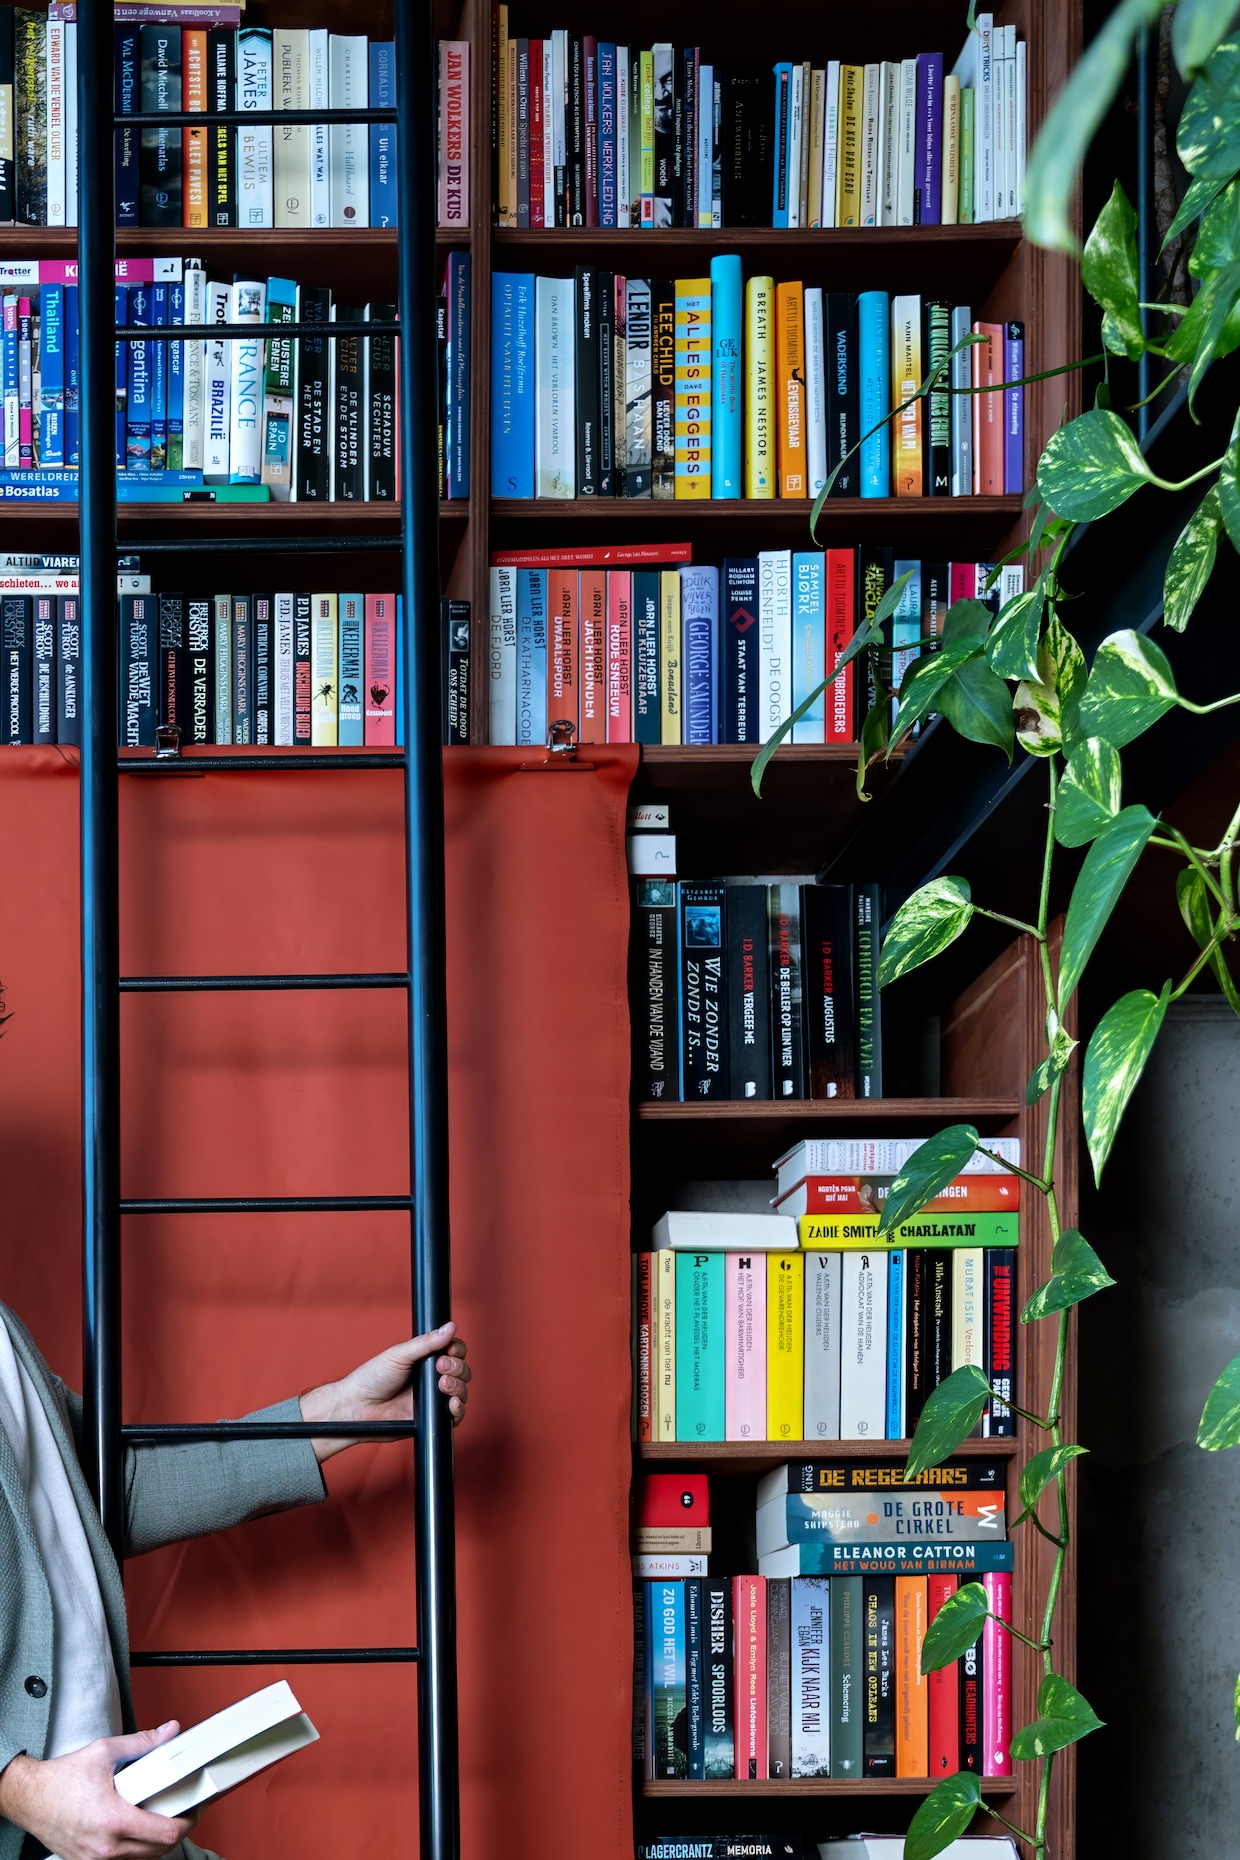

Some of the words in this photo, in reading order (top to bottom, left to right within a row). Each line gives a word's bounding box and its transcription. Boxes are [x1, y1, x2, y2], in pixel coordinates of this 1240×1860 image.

[244, 50, 255, 109] JAMES
[448, 51, 461, 80] JAN
[602, 52, 613, 76] JAN
[448, 82, 461, 159] WOLKERS
[602, 81, 613, 136] WOLKERS
[448, 166, 461, 185] DE
[602, 140, 613, 225] WERKKLEDING
[448, 190, 461, 220] KUS
[47, 291, 59, 353] Thailand
[757, 292, 765, 340] BREATH
[686, 312, 700, 378] ALLES
[758, 361, 766, 403] JAMES
[210, 380, 224, 440] BRAZILIË
[788, 380, 800, 448] LEVENSGEVAAR
[686, 395, 700, 473] EGGERS
[758, 408, 766, 457] NESTOR
[6, 556, 41, 568] ALTIJD
[55, 580, 69, 588] we
[491, 615, 500, 631] DE
[610, 625, 620, 659] RODE
[194, 658, 206, 673] DE
[491, 636, 501, 680] FJORD
[584, 620, 594, 719] JACHTHONDEN
[738, 639, 746, 670] STAAT
[610, 662, 620, 718] SNEEUW
[738, 673, 746, 693] VAN
[194, 678, 206, 740] VERRADER
[738, 696, 746, 742] TERREUR
[744, 992, 754, 1029] VERGEEF
[824, 995, 835, 1043] AUGUSTUS
[744, 1031, 754, 1044] ME
[807, 1226, 839, 1238] ZADIE
[843, 1226, 877, 1238] SMITH
[901, 1224, 975, 1237] CHARLATAN
[993, 1279, 1010, 1371] UNWINDING
[883, 1502, 903, 1516] DE
[913, 1501, 964, 1516] GROTE
[896, 1519, 953, 1534] CIRKEL
[834, 1547, 907, 1558] ELEANOR
[913, 1547, 975, 1558] CATTON
[834, 1561, 857, 1570] HET
[860, 1561, 896, 1570] WOUD
[900, 1561, 924, 1570] VAN
[928, 1561, 975, 1570] BIRNAM
[711, 1591, 724, 1654] DISHER
[712, 1664, 726, 1733] SPOORLOOS
[646, 1844, 712, 1858] LAGERCRANTZ
[728, 1845, 772, 1855] MEMORIA
